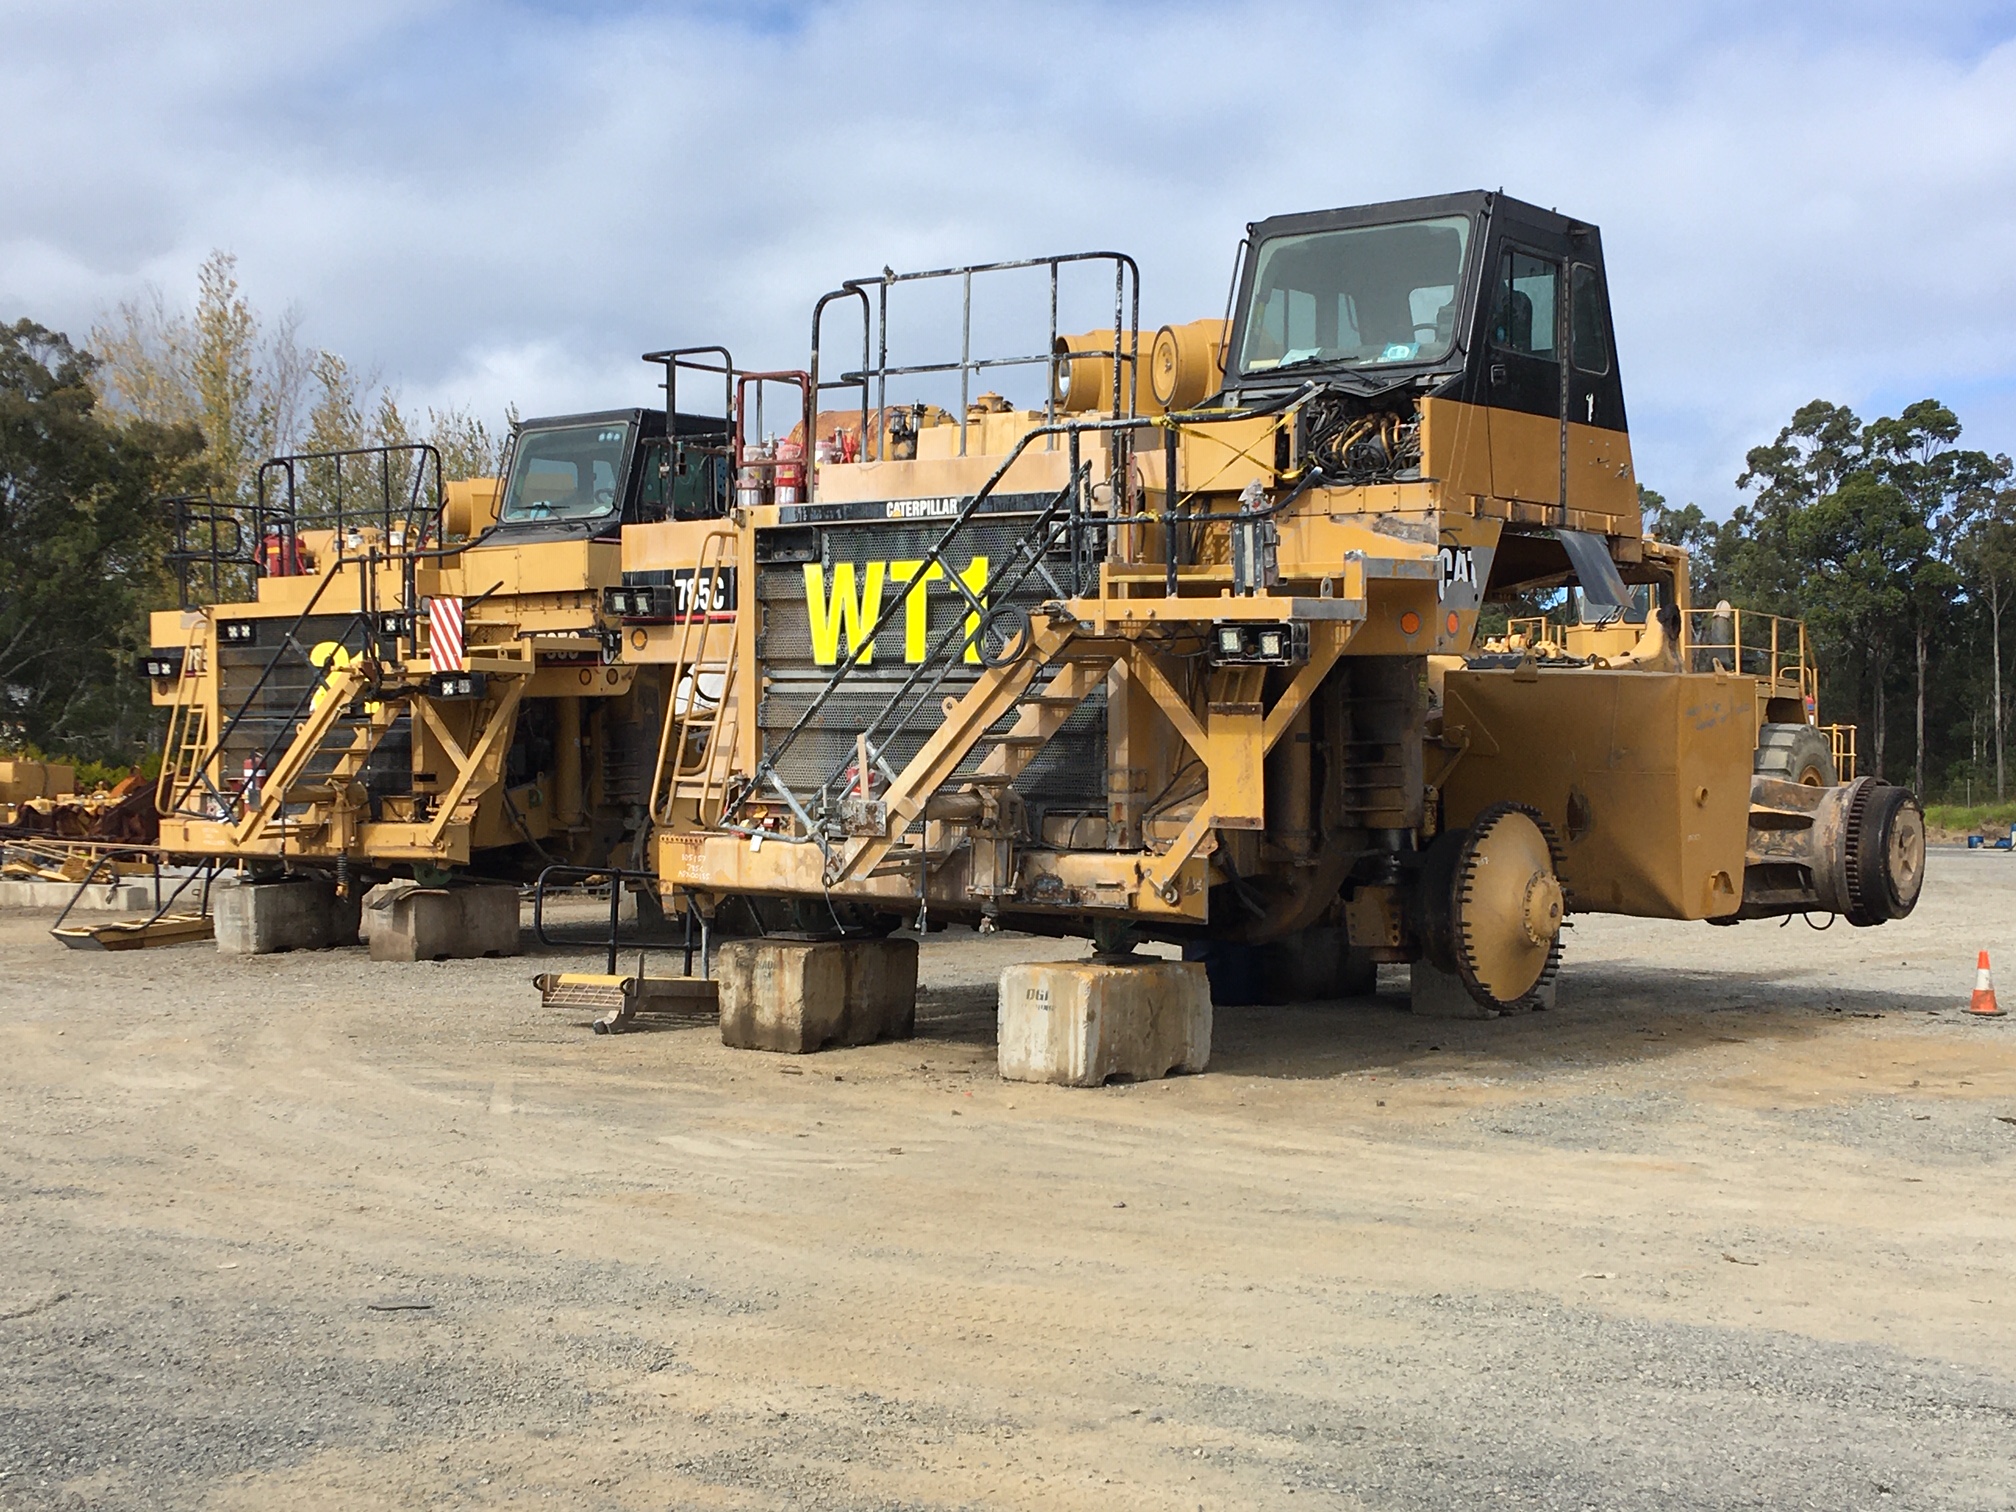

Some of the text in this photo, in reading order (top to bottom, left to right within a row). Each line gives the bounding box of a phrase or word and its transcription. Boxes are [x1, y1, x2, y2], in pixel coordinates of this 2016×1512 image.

[886, 499, 957, 518] CATERPILLAR
[675, 577, 725, 611] 785C
[803, 556, 989, 665] WT1
